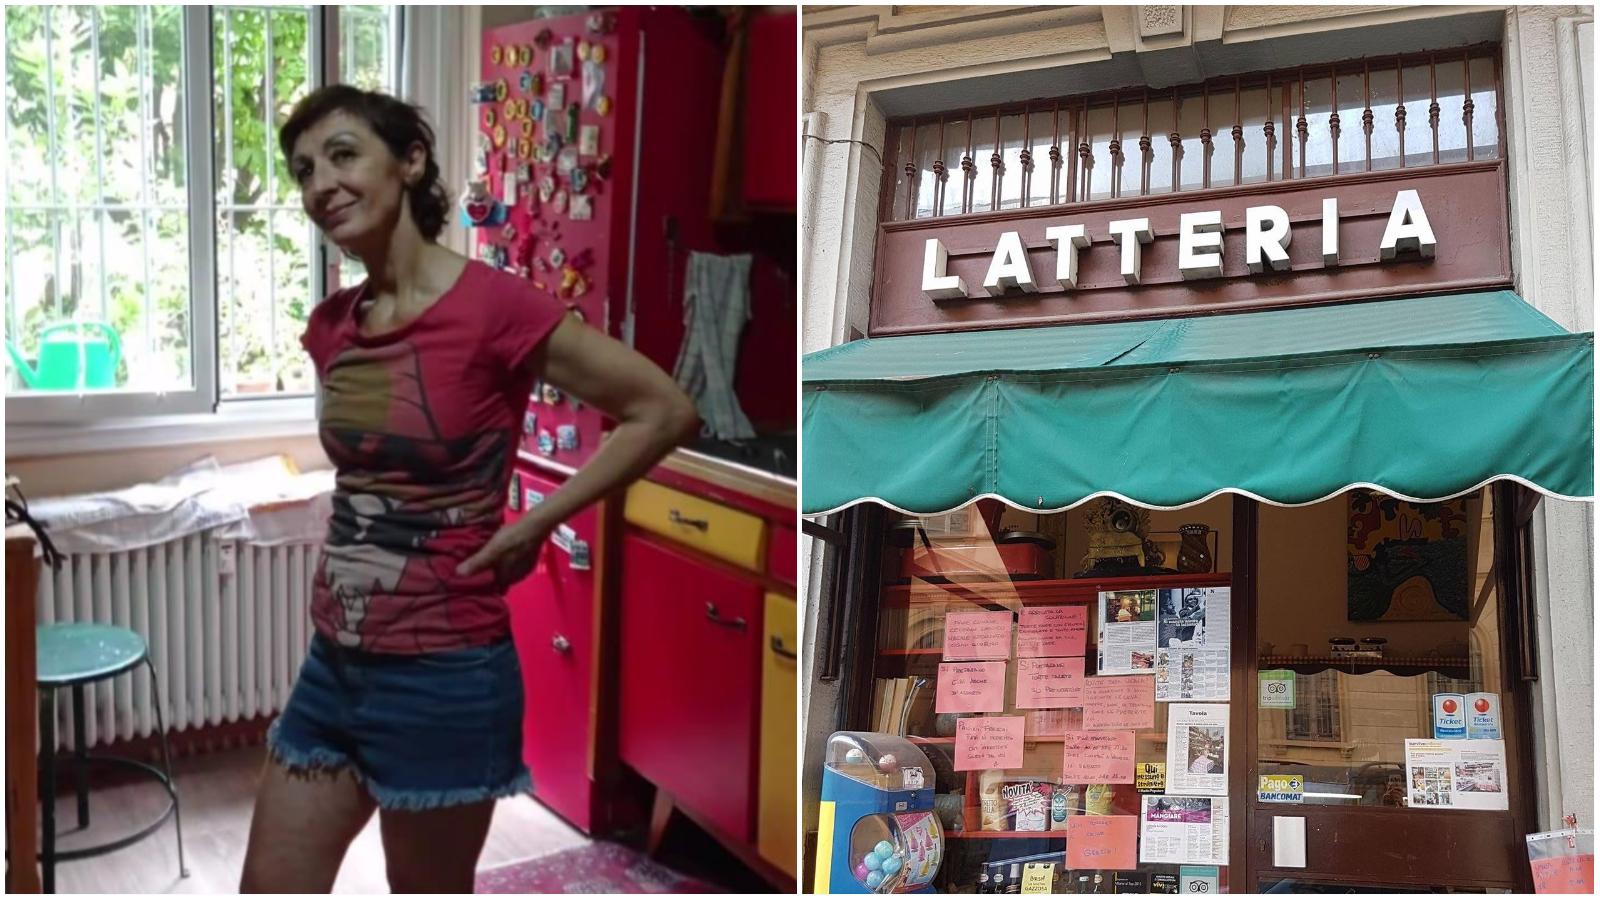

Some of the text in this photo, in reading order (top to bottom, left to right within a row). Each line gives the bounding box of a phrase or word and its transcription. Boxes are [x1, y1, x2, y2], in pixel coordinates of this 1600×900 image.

[922, 189, 1438, 301] LATTERIA
[1144, 763, 1158, 775] Qui
[1260, 776, 1288, 791] Pago
[1260, 792, 1303, 801] BANCOMAT
